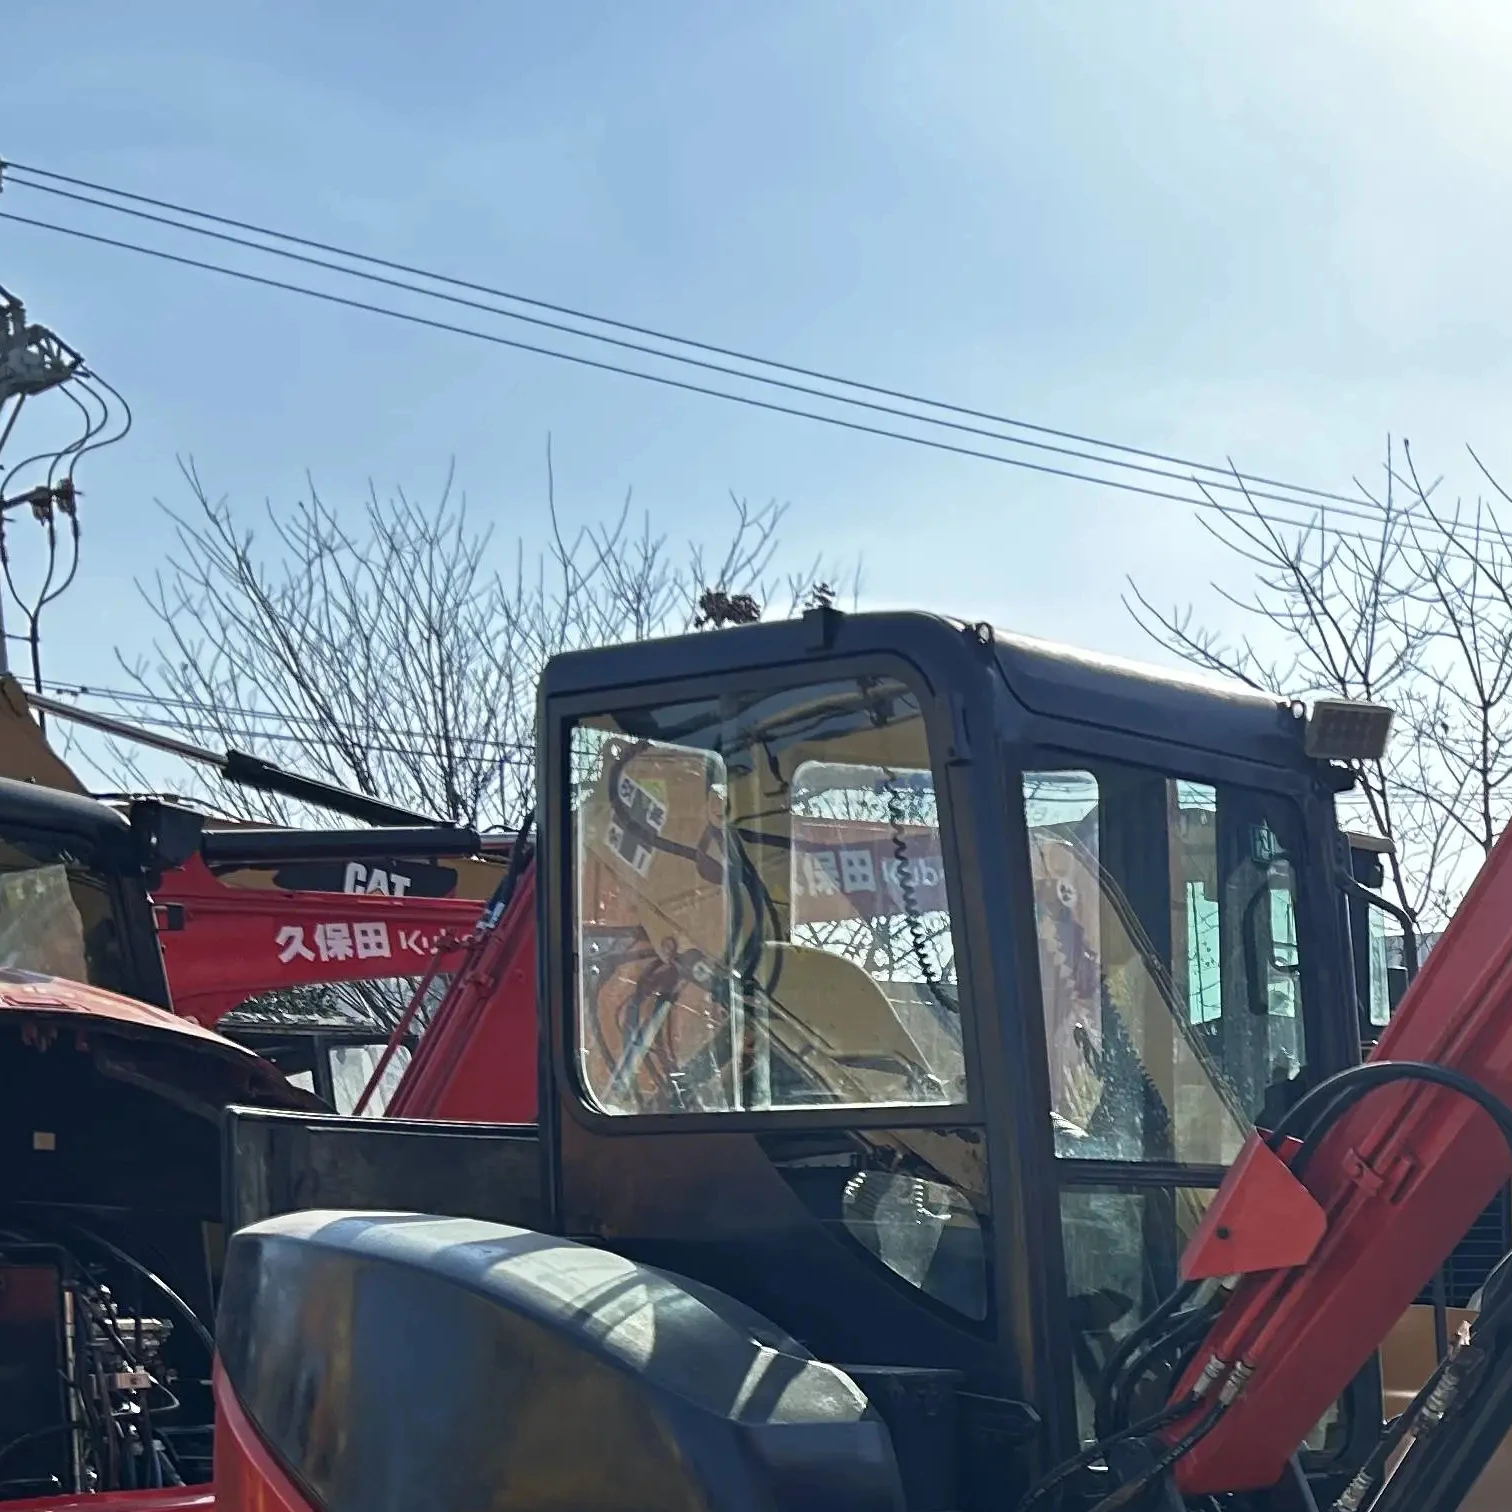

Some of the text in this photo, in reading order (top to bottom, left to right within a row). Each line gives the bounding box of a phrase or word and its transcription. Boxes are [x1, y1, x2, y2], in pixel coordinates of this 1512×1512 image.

[344, 861, 412, 898] CAT
[275, 921, 392, 964] 久保田
